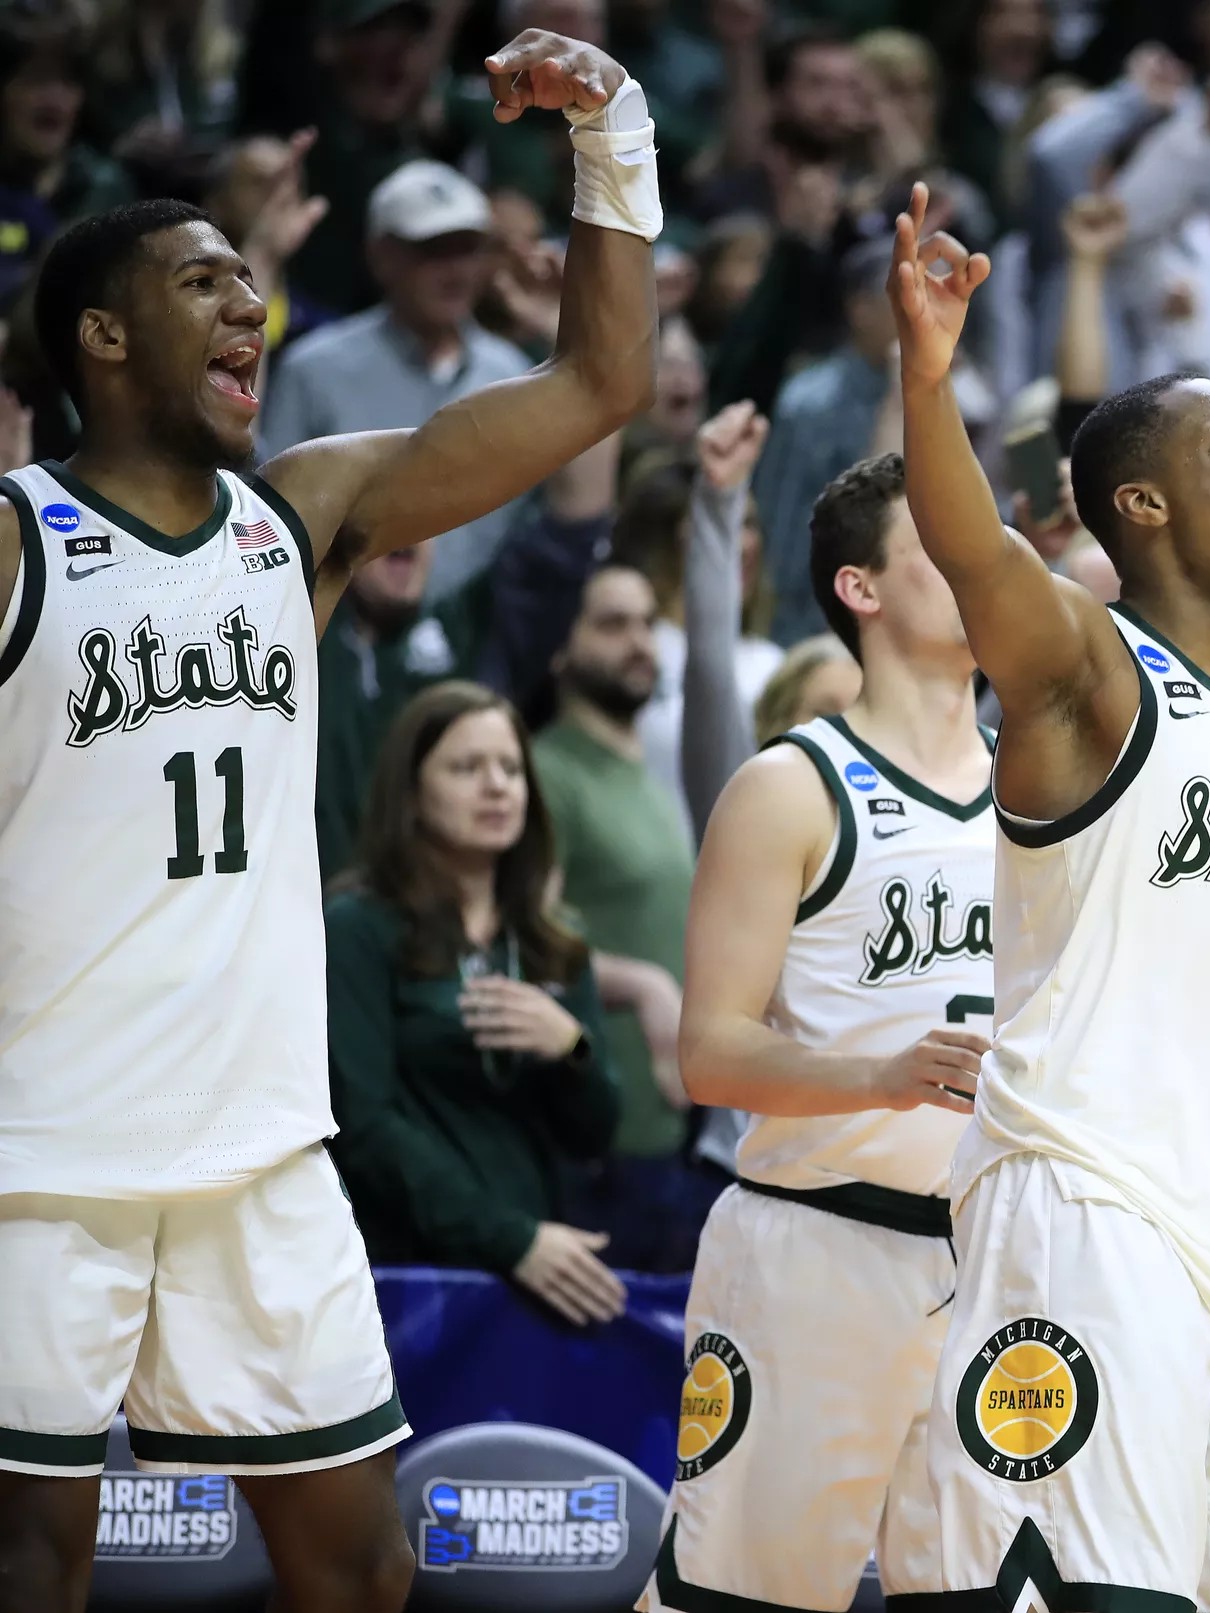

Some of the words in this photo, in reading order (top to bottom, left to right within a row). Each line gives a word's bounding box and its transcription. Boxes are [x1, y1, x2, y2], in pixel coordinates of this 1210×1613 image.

[47, 515, 79, 526] NCAA
[75, 541, 102, 551] GUS
[66, 605, 298, 747] State
[1143, 654, 1168, 668] NCAA
[163, 747, 248, 879] 11
[858, 869, 993, 986] Sta
[981, 1321, 1083, 1364] MICHIGAN
[988, 1389, 1065, 1410] SPARTANS
[988, 1454, 1054, 1480] STATE
[99, 1478, 174, 1512] ARCH
[460, 1487, 567, 1521] MARCH
[477, 1521, 622, 1556] MADNESS
